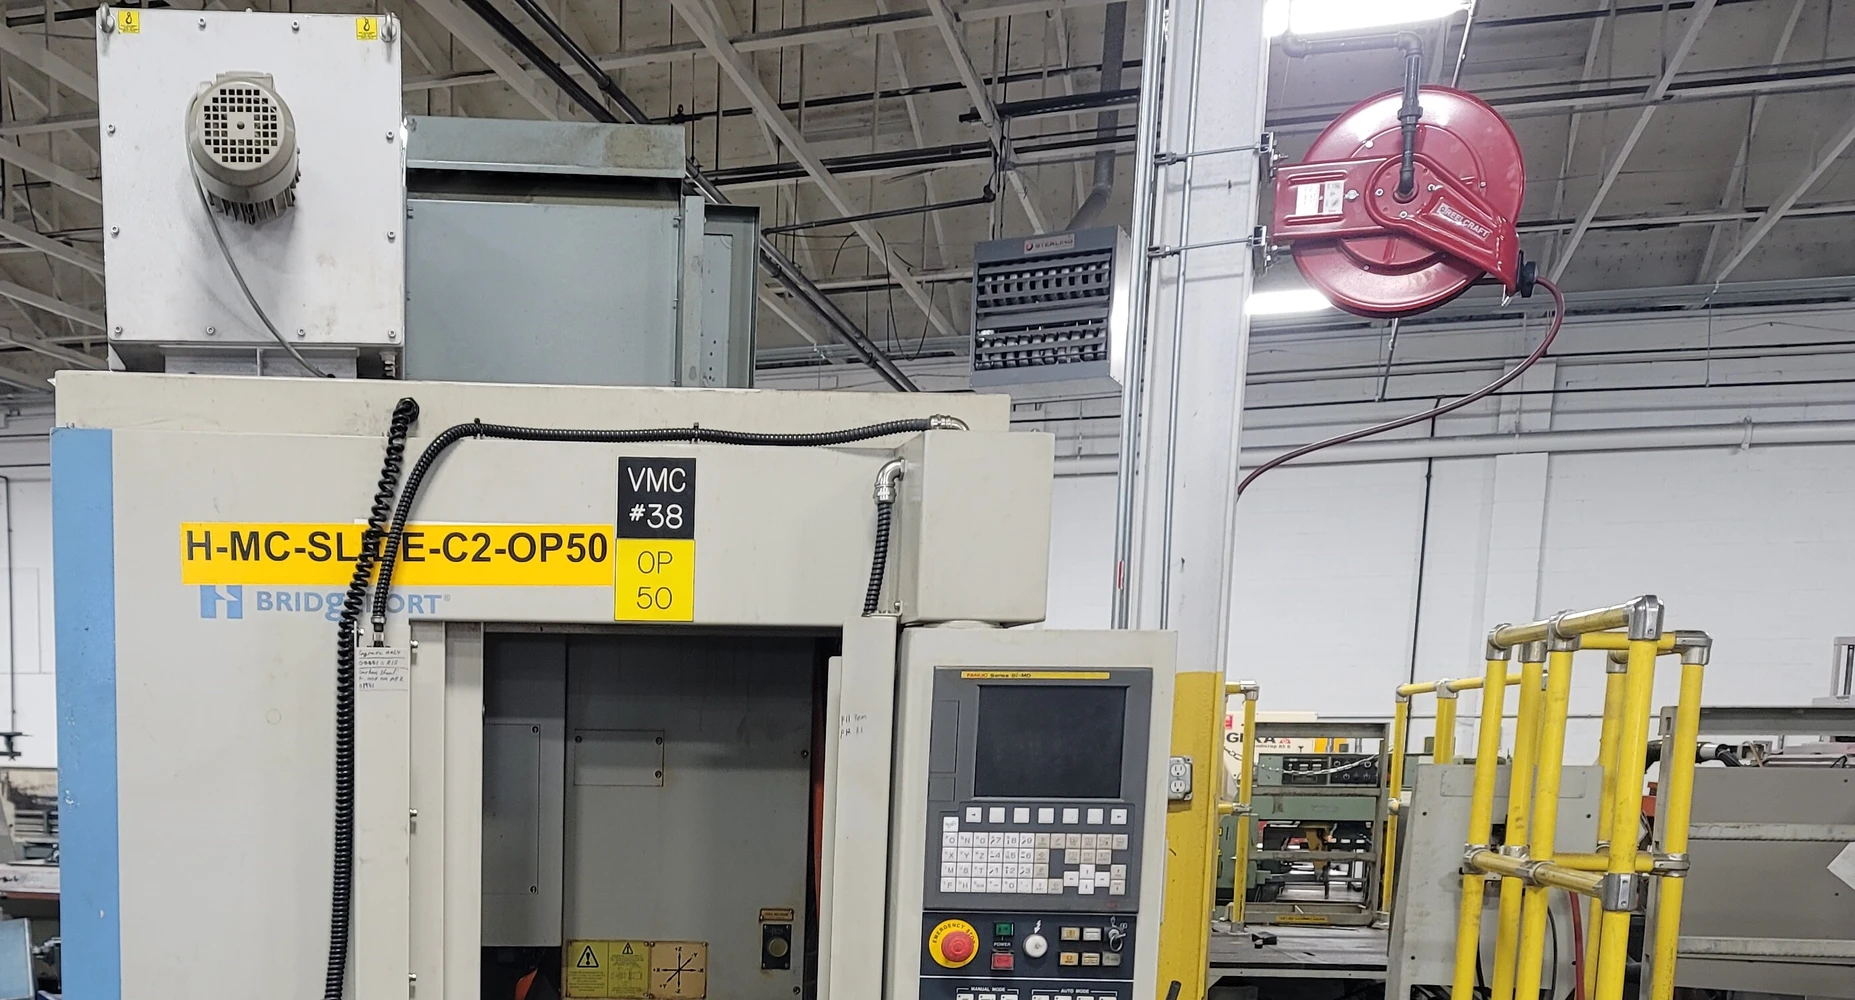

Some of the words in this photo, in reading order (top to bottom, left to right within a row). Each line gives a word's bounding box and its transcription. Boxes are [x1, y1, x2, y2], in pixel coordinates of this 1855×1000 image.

[1445, 206, 1490, 238] REELCRAFT
[626, 466, 687, 493] VMC
[628, 503, 684, 530] #38
[186, 530, 608, 564] H-MC-SLE-C2-OP50
[637, 550, 674, 575] OP
[636, 586, 673, 610] 50
[932, 922, 965, 944] EMERGENCY
